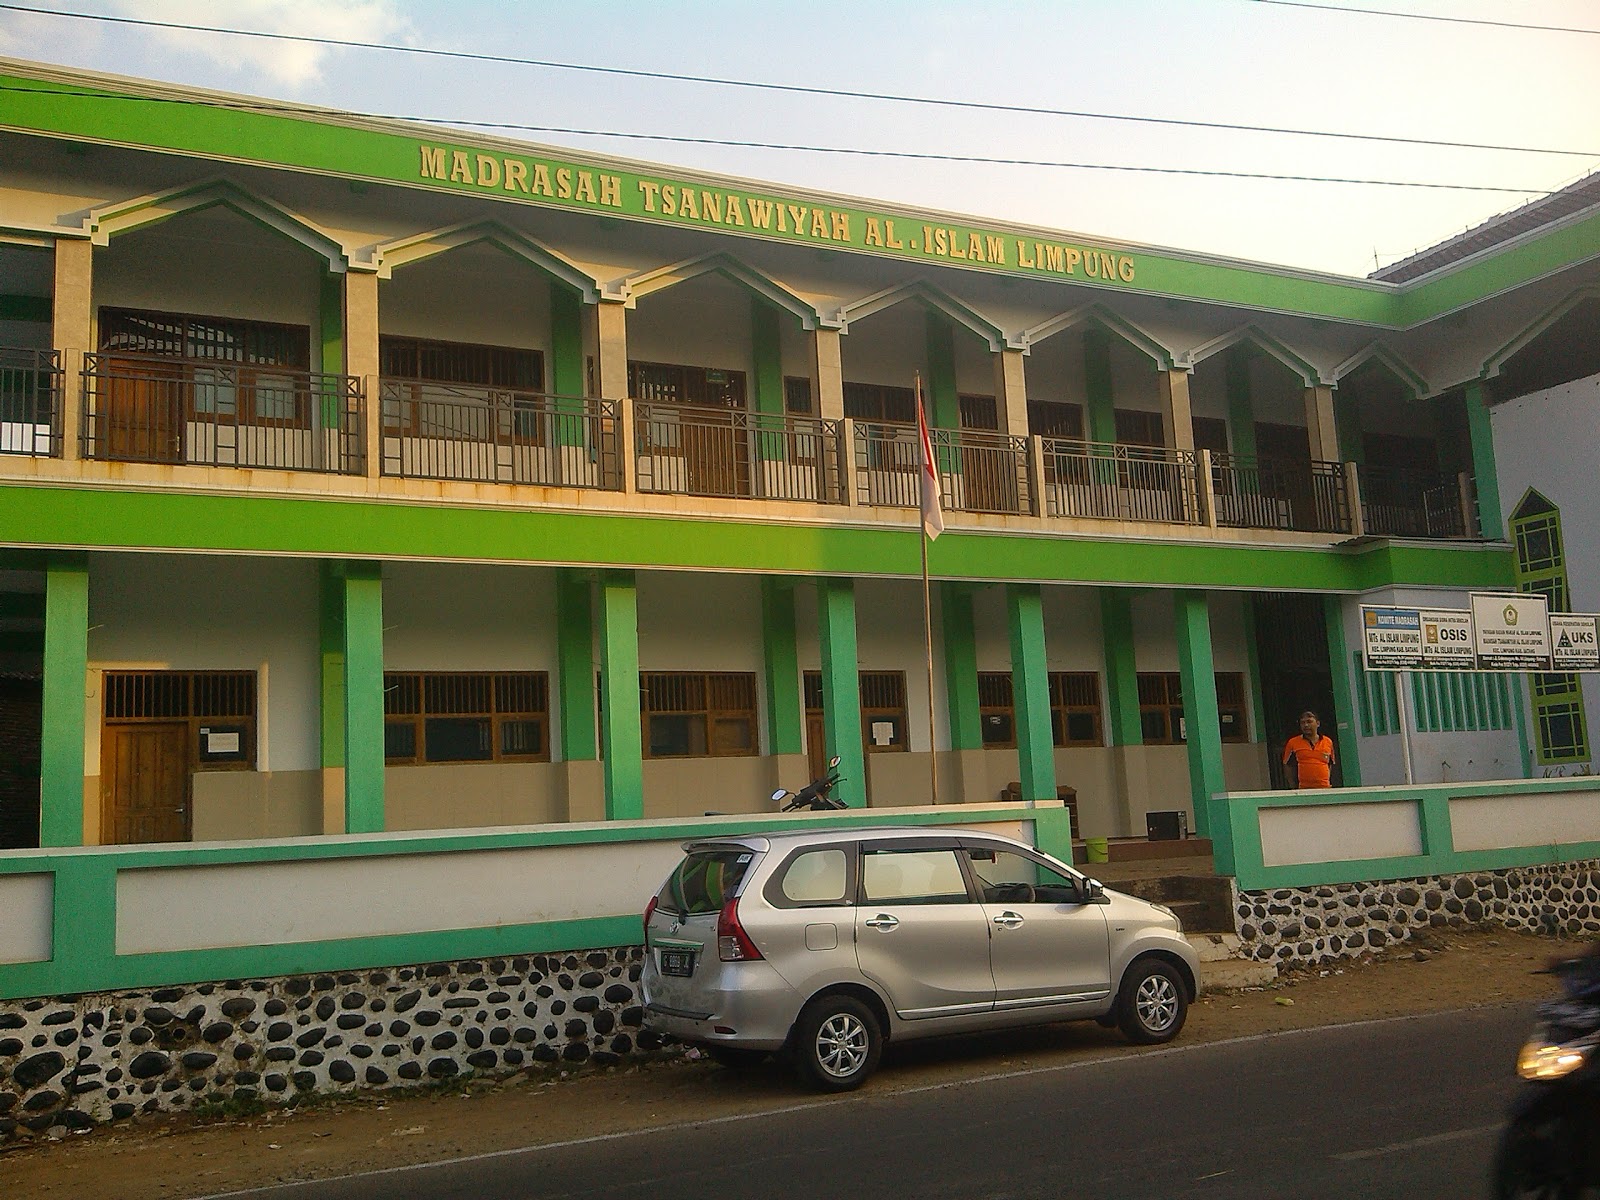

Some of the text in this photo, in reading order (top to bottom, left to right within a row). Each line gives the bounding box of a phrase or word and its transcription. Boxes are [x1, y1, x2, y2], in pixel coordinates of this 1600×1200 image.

[420, 145, 622, 207] MADRASAH
[638, 180, 851, 242] TSANAWIYAH
[923, 226, 1006, 265] ISLAM
[1017, 240, 1136, 282] LIMPUNG
[1380, 633, 1385, 642] AL
[1440, 629, 1467, 641] OSIS
[1572, 632, 1593, 643] UKS
